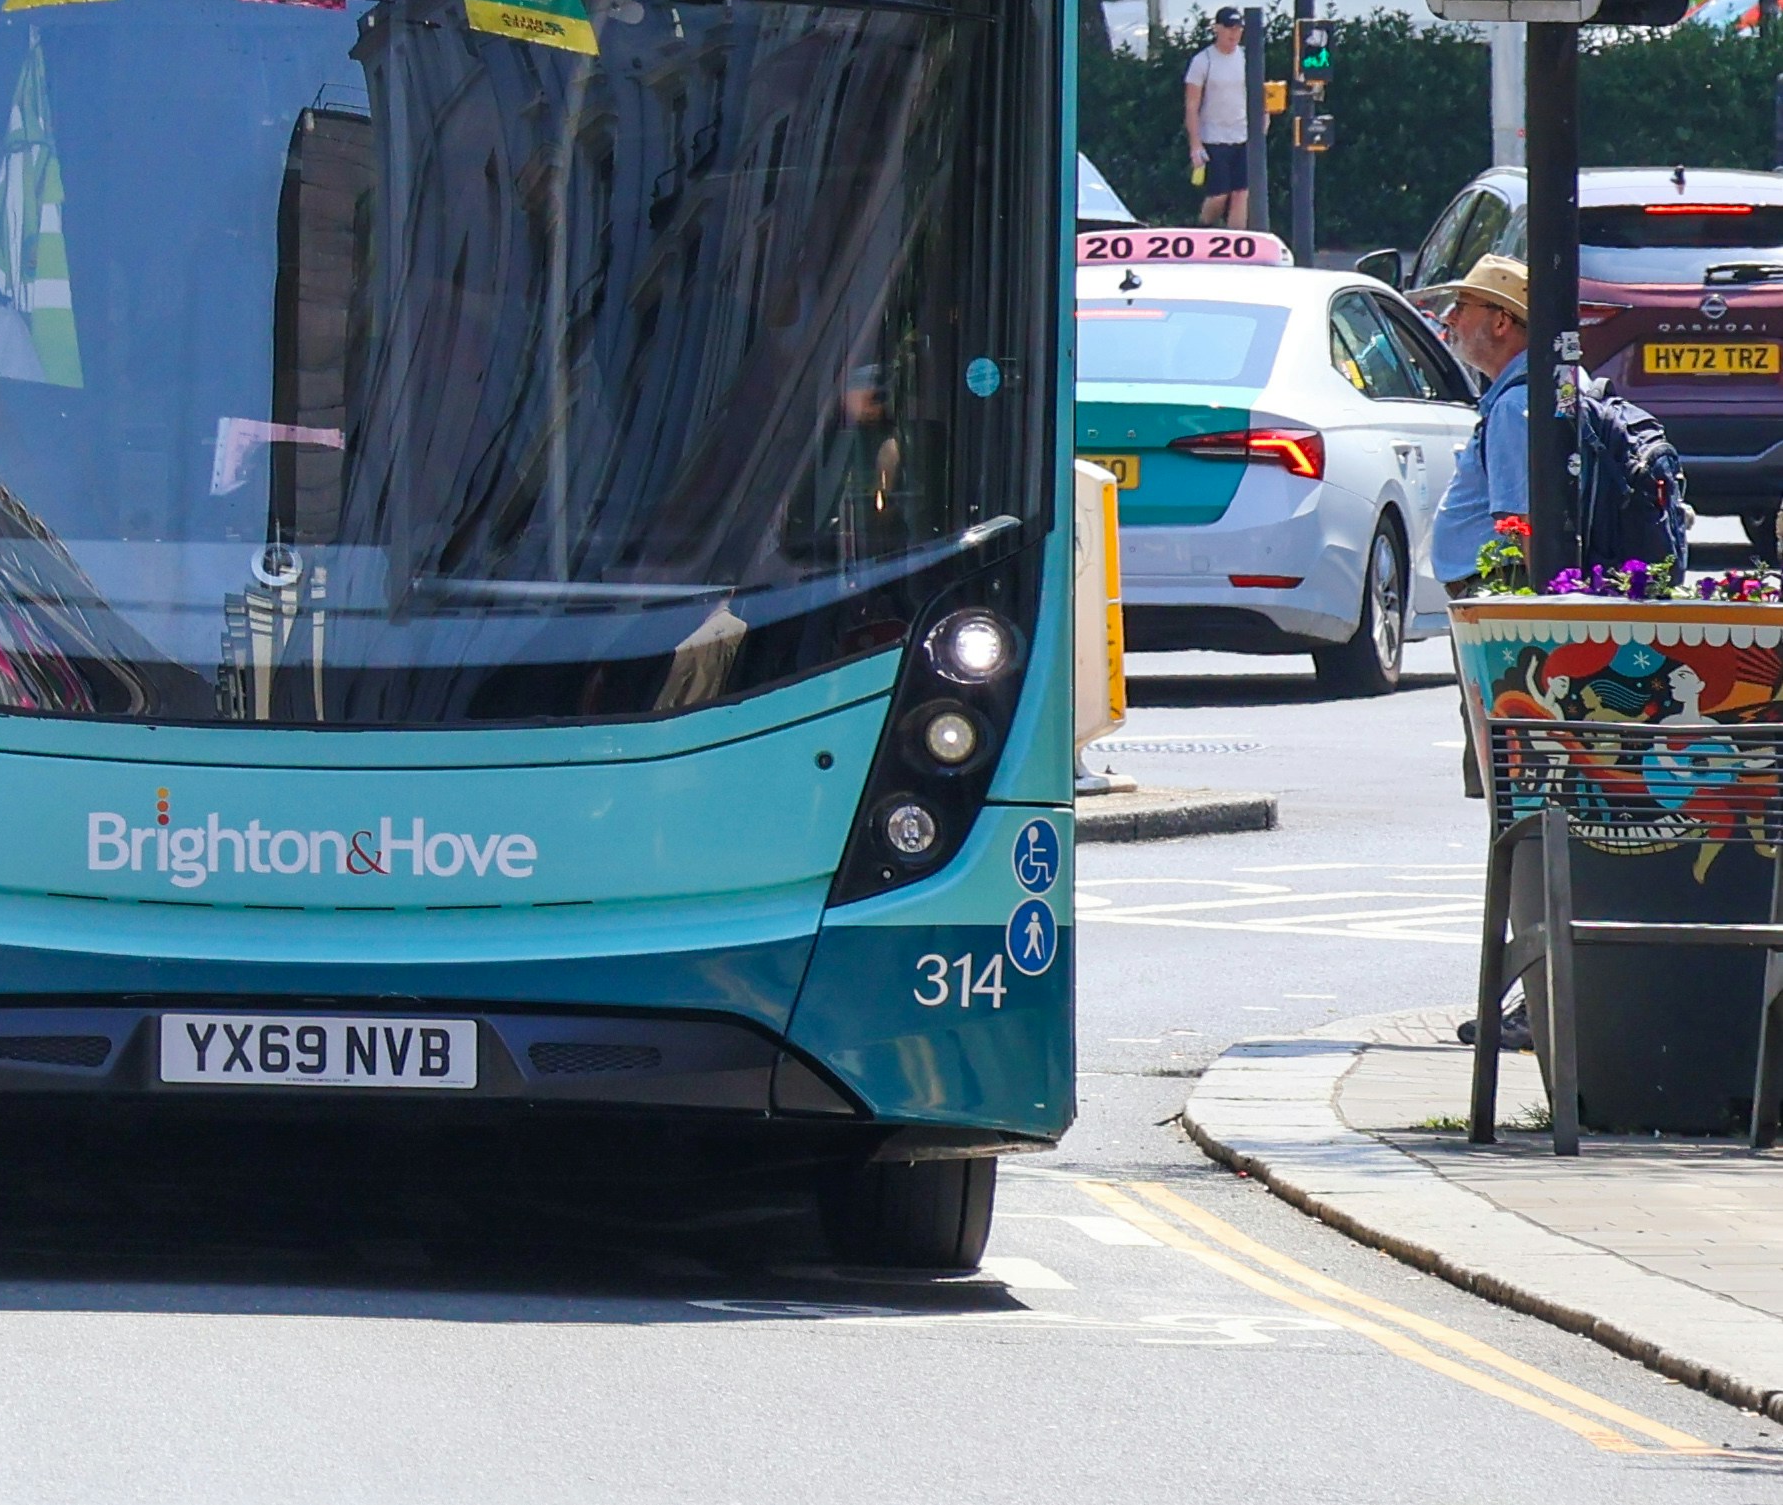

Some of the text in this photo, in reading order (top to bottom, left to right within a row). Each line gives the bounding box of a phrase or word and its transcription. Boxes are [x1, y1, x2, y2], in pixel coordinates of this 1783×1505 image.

[1085, 236, 1256, 260] 20 20 20
[1655, 347, 1770, 370] HY72 TRZ
[913, 952, 1008, 1009] 314
[186, 1022, 451, 1076] YX69 NVB
